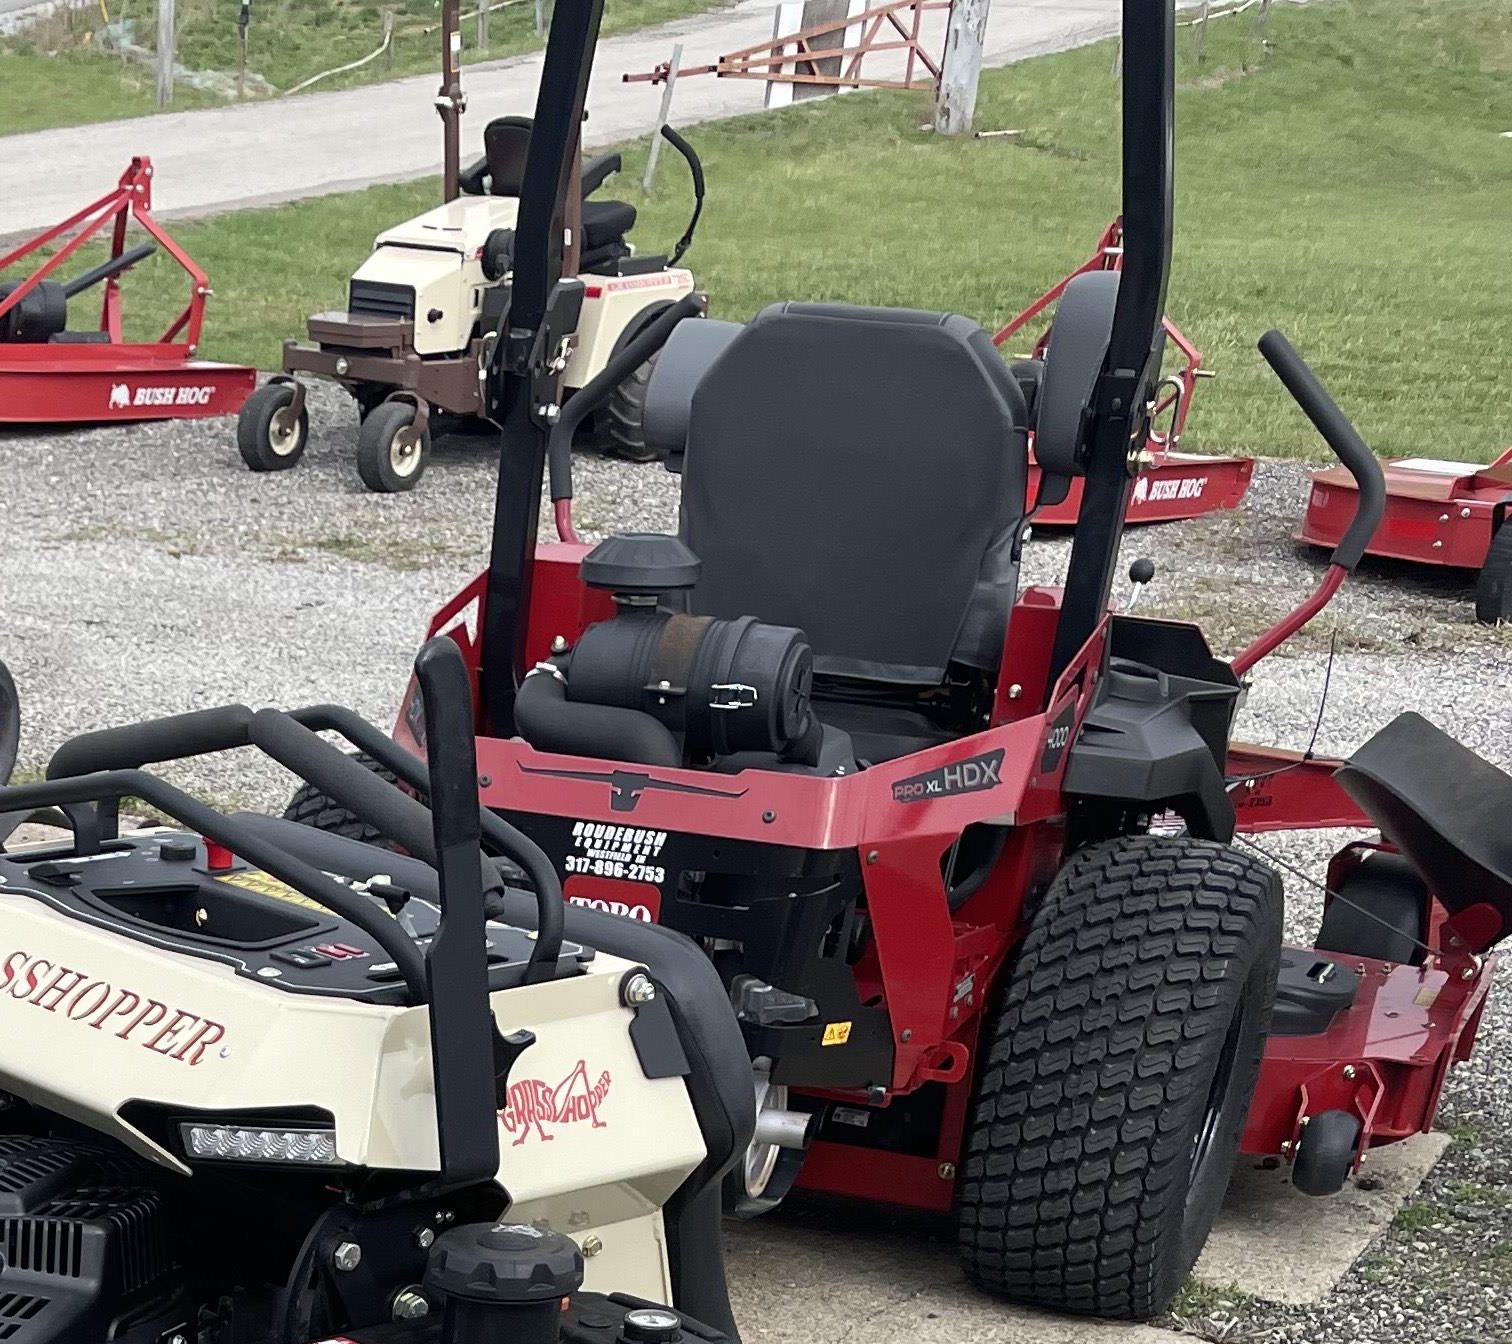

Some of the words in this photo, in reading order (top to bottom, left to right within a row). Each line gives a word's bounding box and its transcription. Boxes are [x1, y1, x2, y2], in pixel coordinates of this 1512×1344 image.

[133, 387, 177, 406] BUSH
[175, 386, 211, 404] HOG
[1148, 480, 1181, 500] BUSH
[1177, 478, 1204, 498] HOG
[1047, 726, 1069, 749] 4000
[894, 784, 924, 800] PRO
[926, 781, 942, 794] XL
[944, 759, 999, 790] HDX
[572, 821, 667, 847] ROUDEBUSH
[574, 836, 662, 857] EQUIPMENT
[586, 848, 632, 862] WESTFIELD
[565, 855, 665, 883] 317-896-2753
